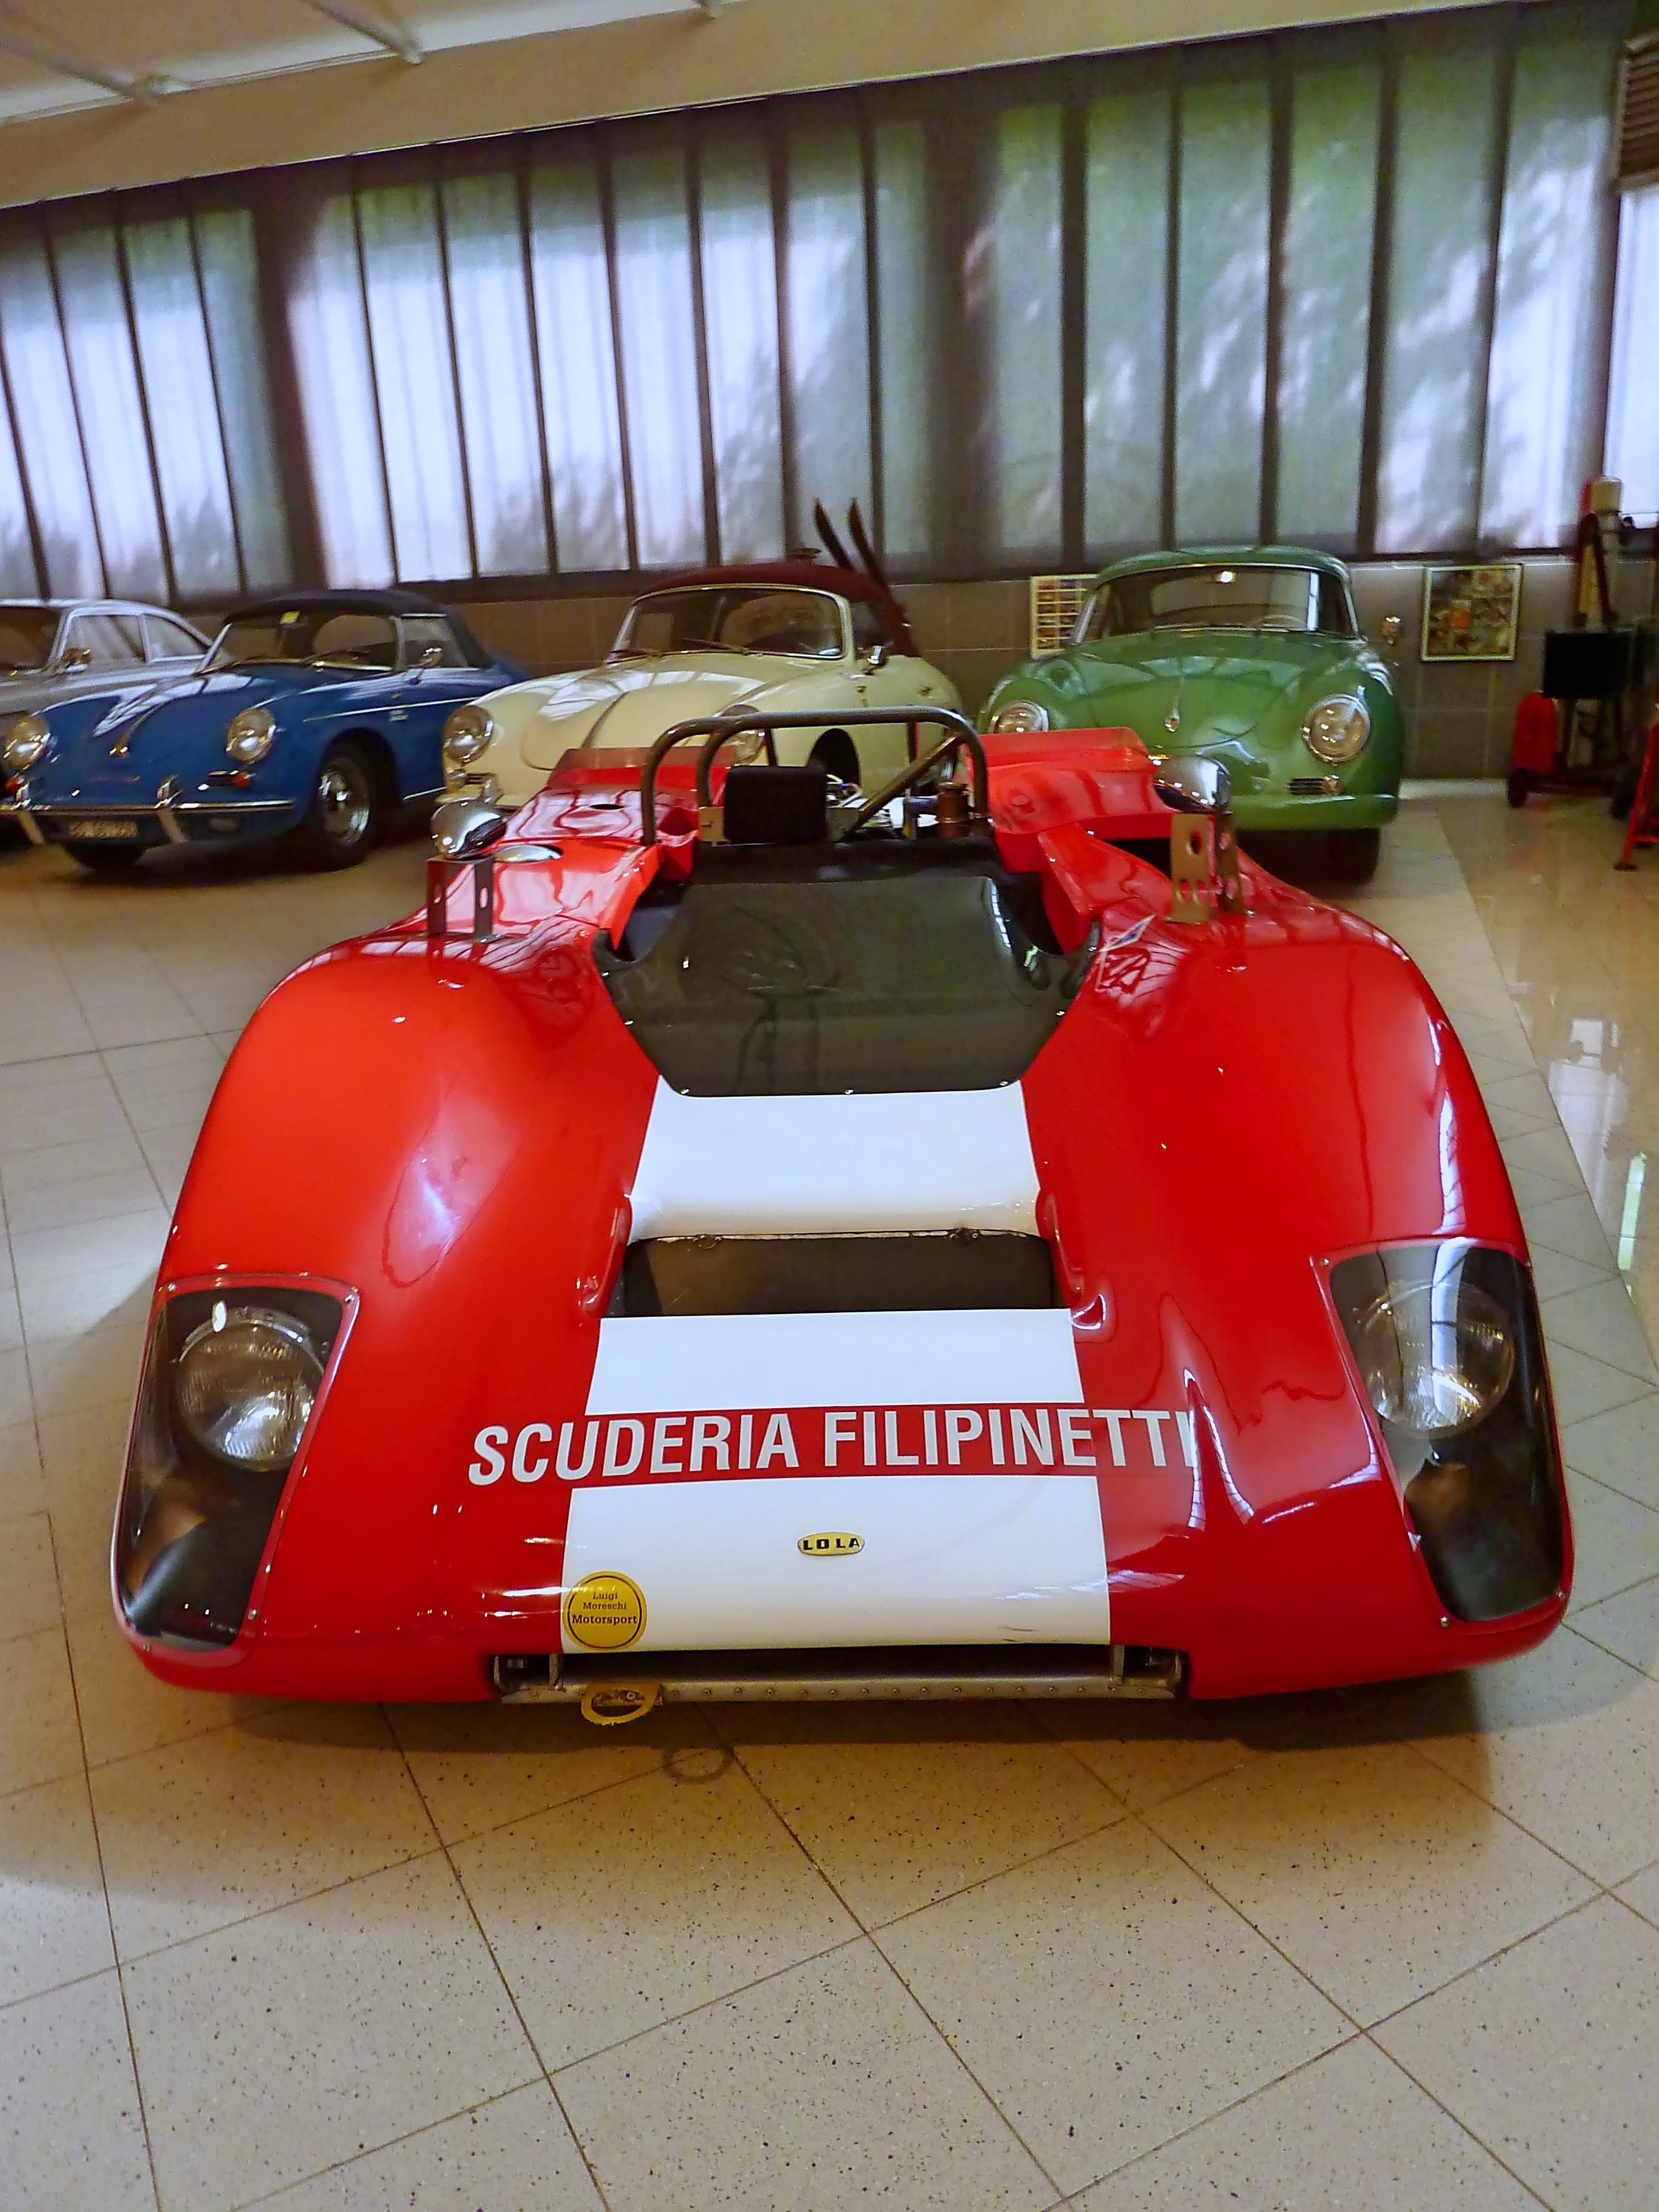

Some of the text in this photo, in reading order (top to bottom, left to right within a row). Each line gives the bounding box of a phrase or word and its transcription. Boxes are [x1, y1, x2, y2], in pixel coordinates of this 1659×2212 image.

[468, 1407, 1198, 1486] SCUDERIA FILIPINETTI
[803, 1538, 860, 1550] LOLA
[593, 1592, 618, 1601] Luigi
[582, 1601, 627, 1610] Moreschi
[572, 1614, 637, 1626] Motorsport
